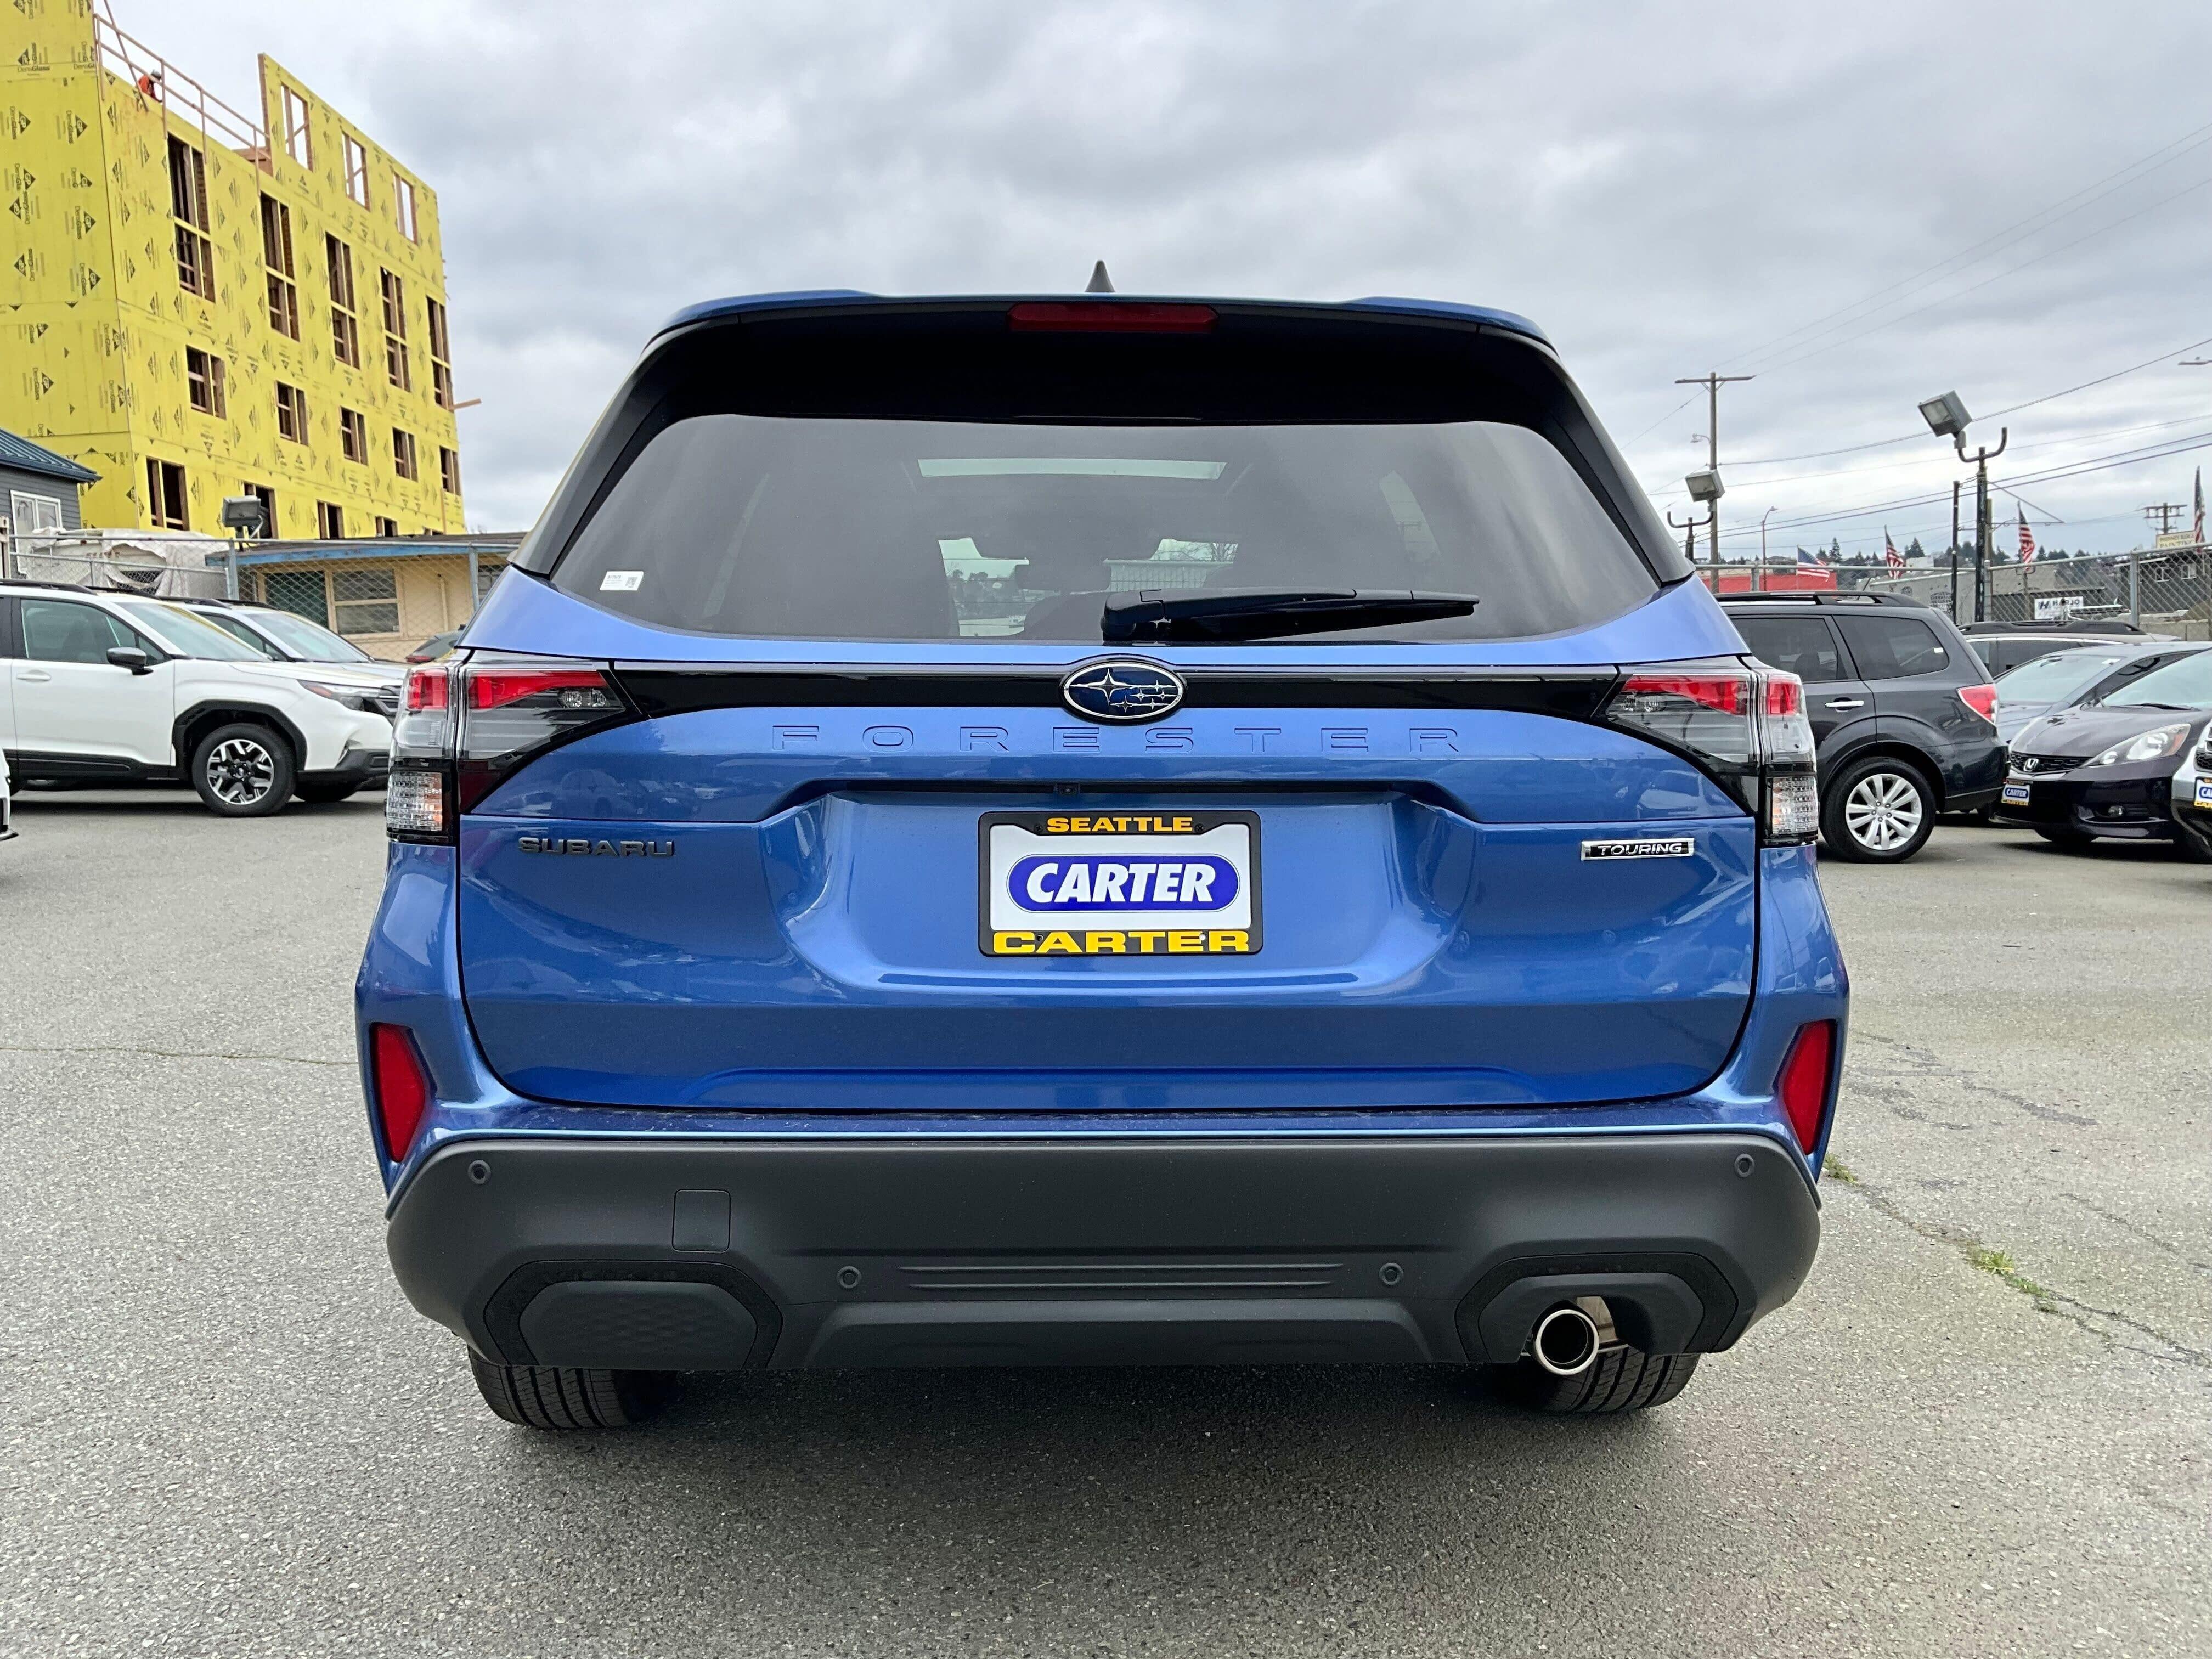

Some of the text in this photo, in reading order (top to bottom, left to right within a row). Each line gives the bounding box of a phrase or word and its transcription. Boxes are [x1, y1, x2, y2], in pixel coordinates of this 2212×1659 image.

[771, 725, 1459, 753] FORESTER
[2006, 788, 2027, 798] CARTER
[1047, 816, 1193, 833] SEATTLE
[518, 837, 675, 856] SUBARU
[1598, 843, 1683, 856] TOURING
[1026, 862, 1216, 904] CARTER
[993, 930, 1250, 954] CARTER
